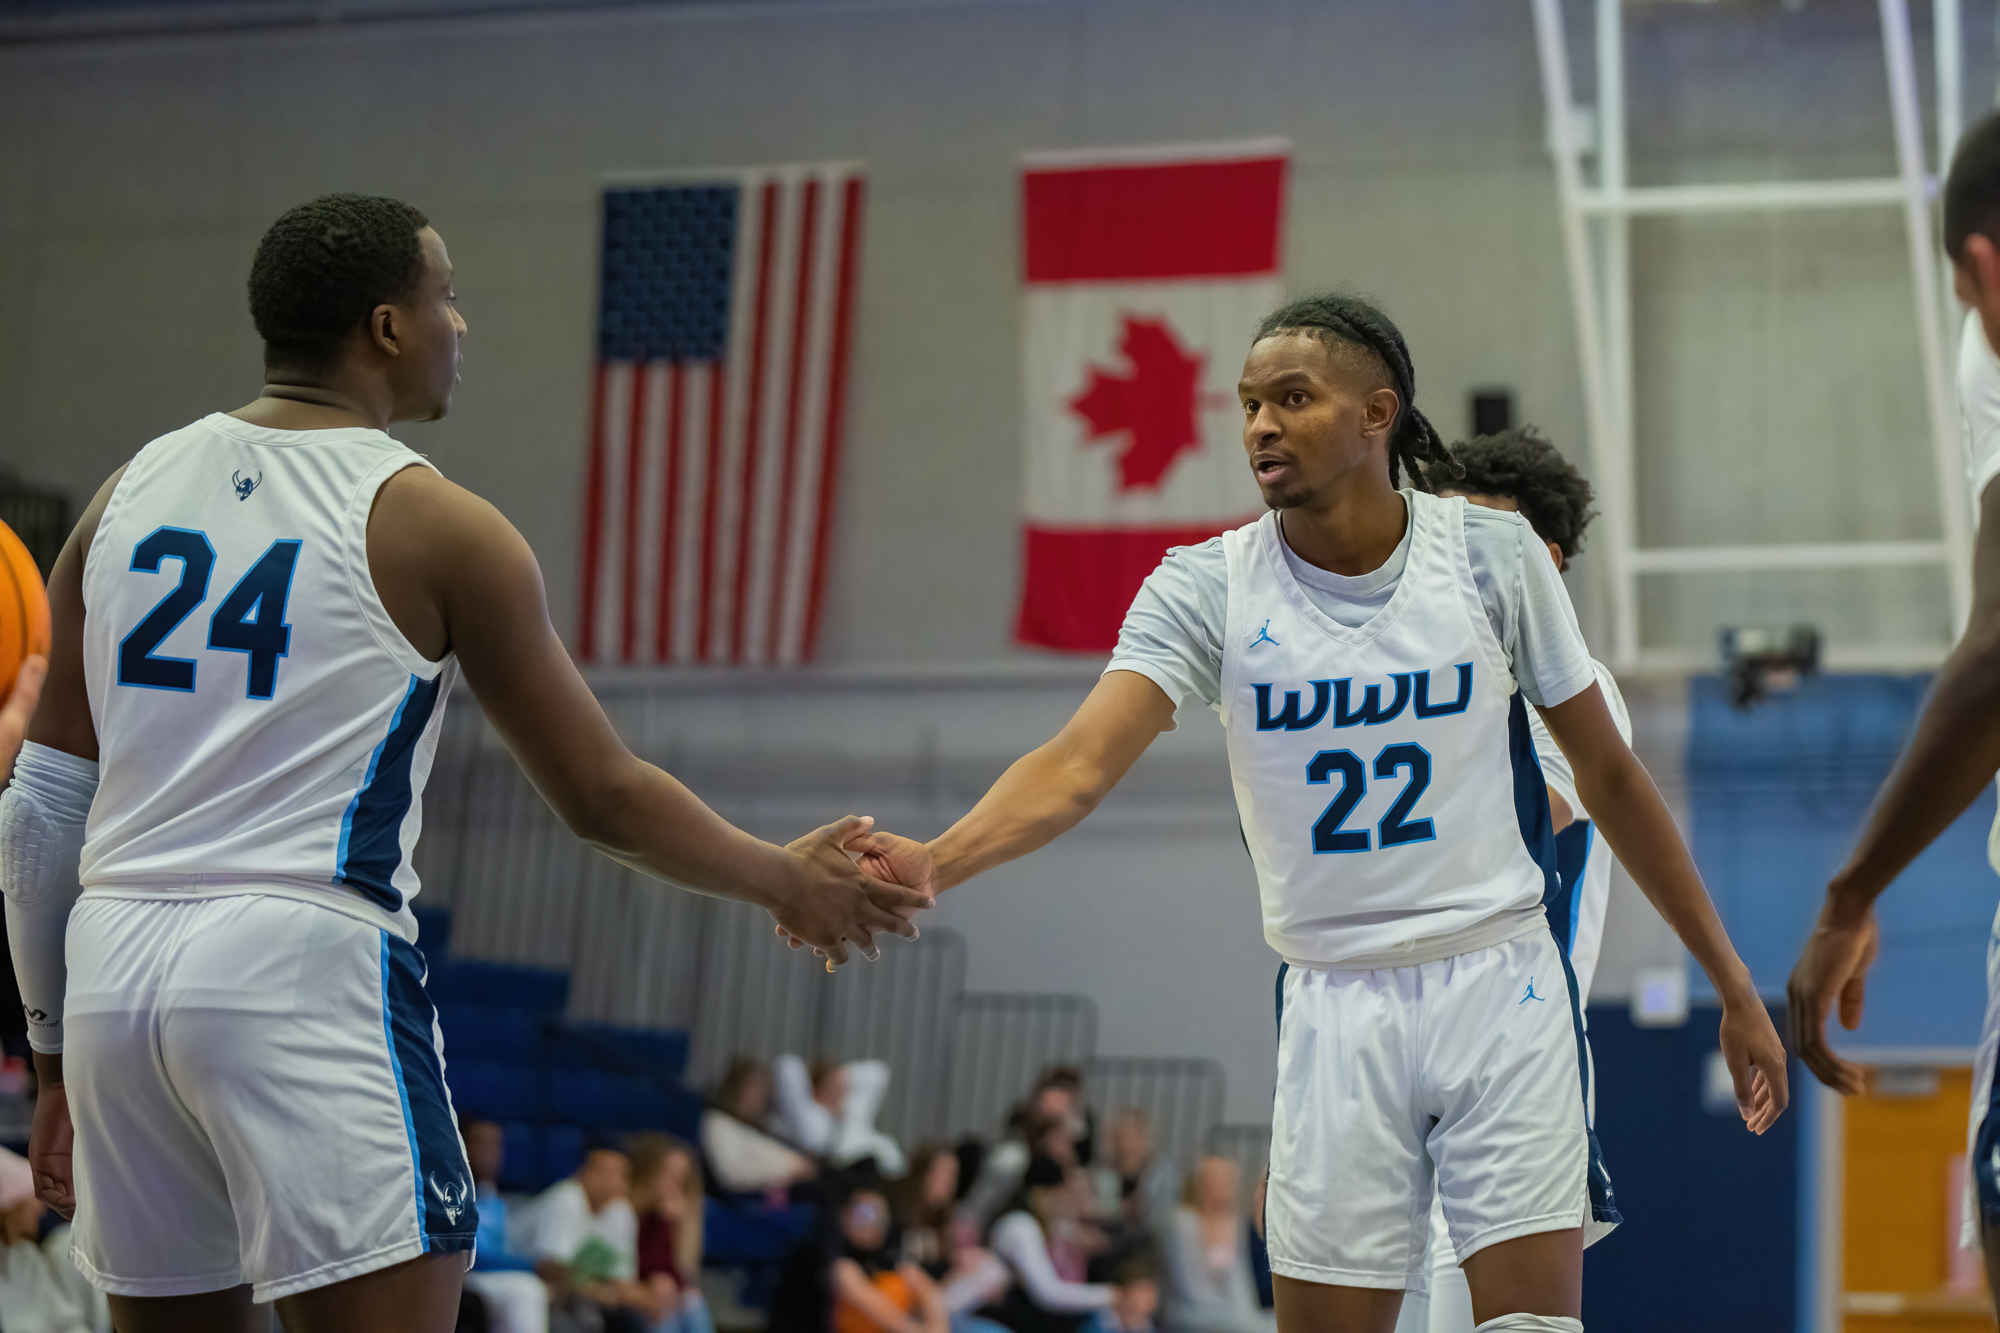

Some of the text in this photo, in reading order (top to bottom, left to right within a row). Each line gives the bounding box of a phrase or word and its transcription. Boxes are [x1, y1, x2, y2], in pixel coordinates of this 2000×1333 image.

[117, 525, 303, 701] 24
[1250, 661, 1474, 732] WWU
[1305, 741, 1436, 855] 22
